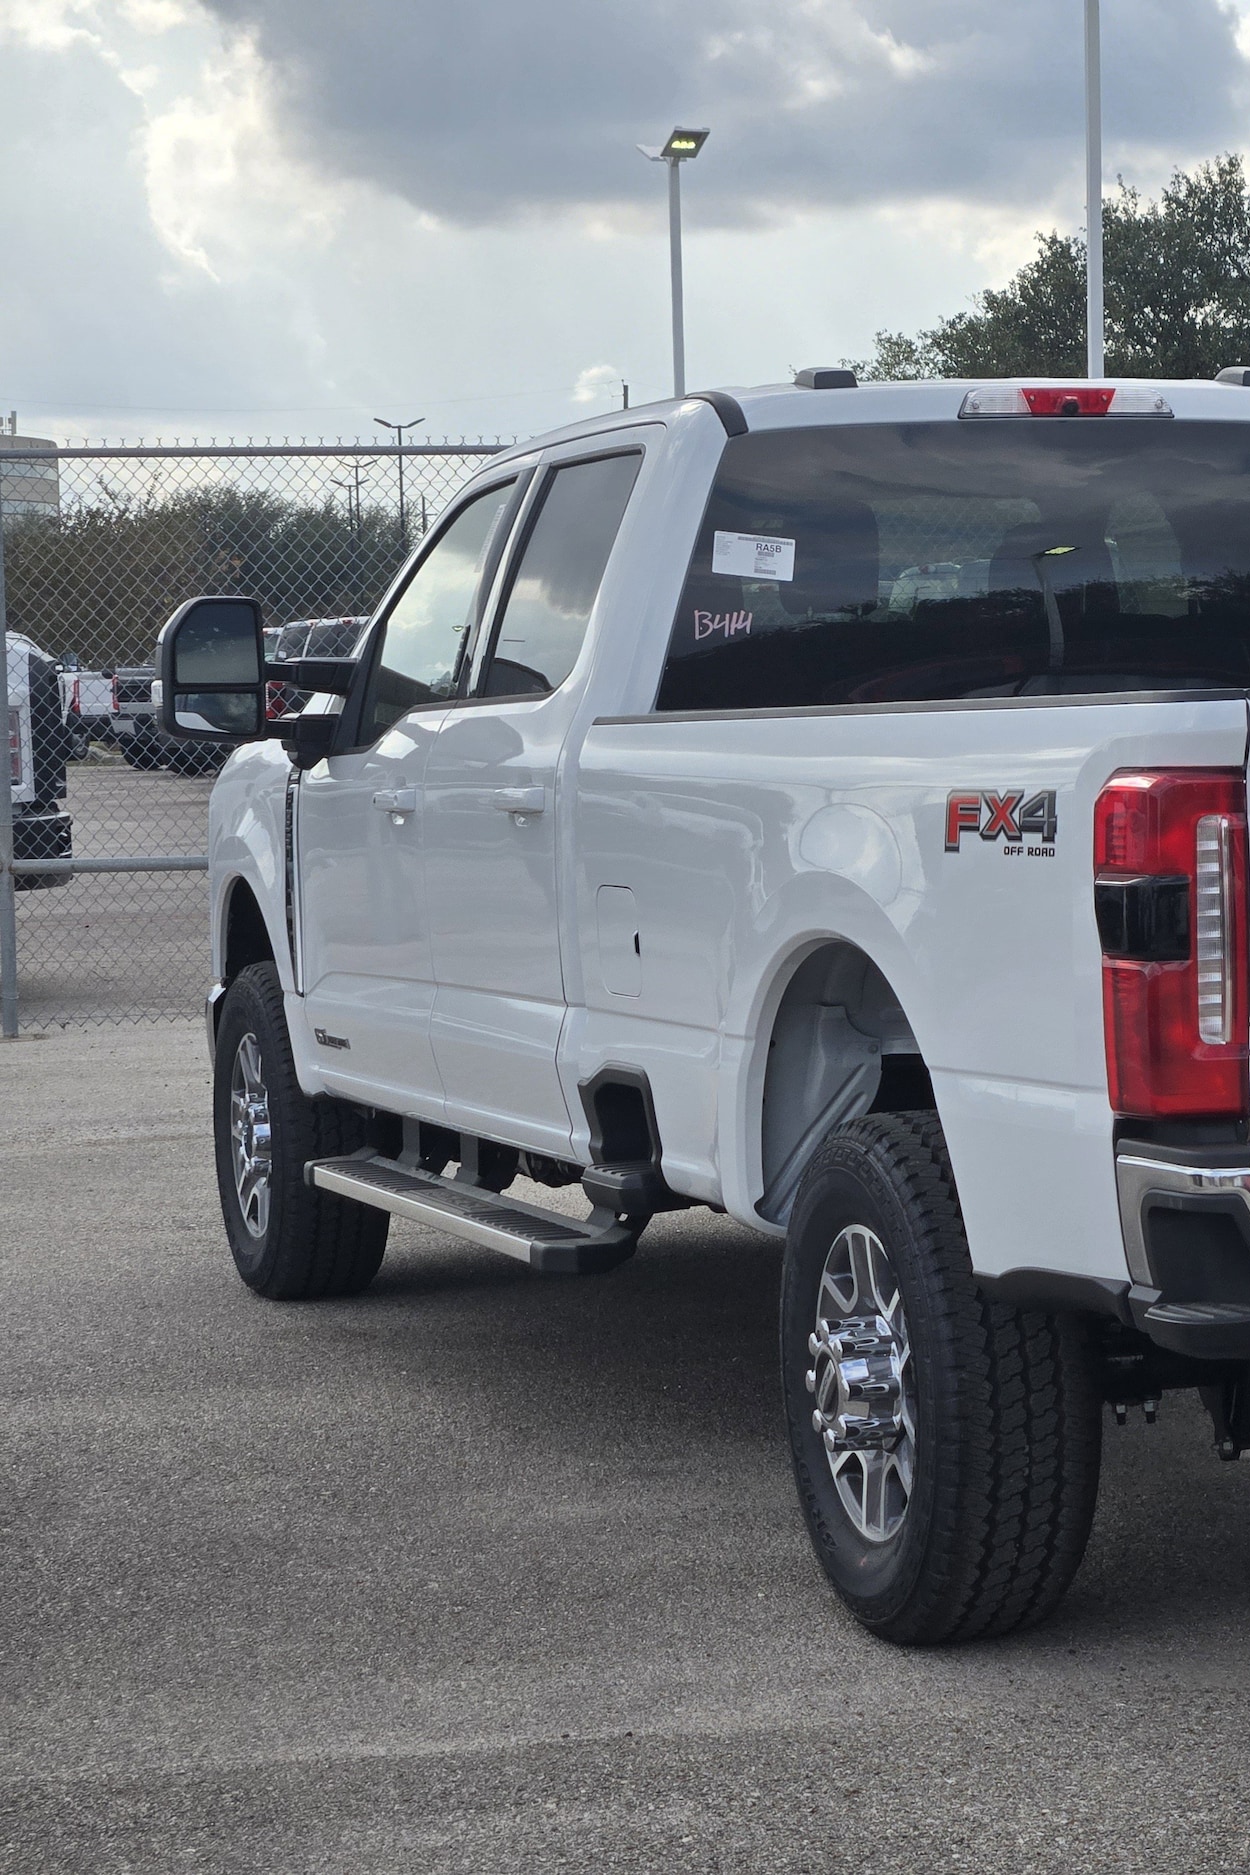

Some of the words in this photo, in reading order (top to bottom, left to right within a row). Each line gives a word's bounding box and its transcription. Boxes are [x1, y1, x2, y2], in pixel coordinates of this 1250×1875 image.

[755, 543, 782, 553] RA5B
[944, 789, 1058, 853] FX4
[1003, 846, 1024, 857] OFF
[1027, 847, 1056, 857] ROAD
